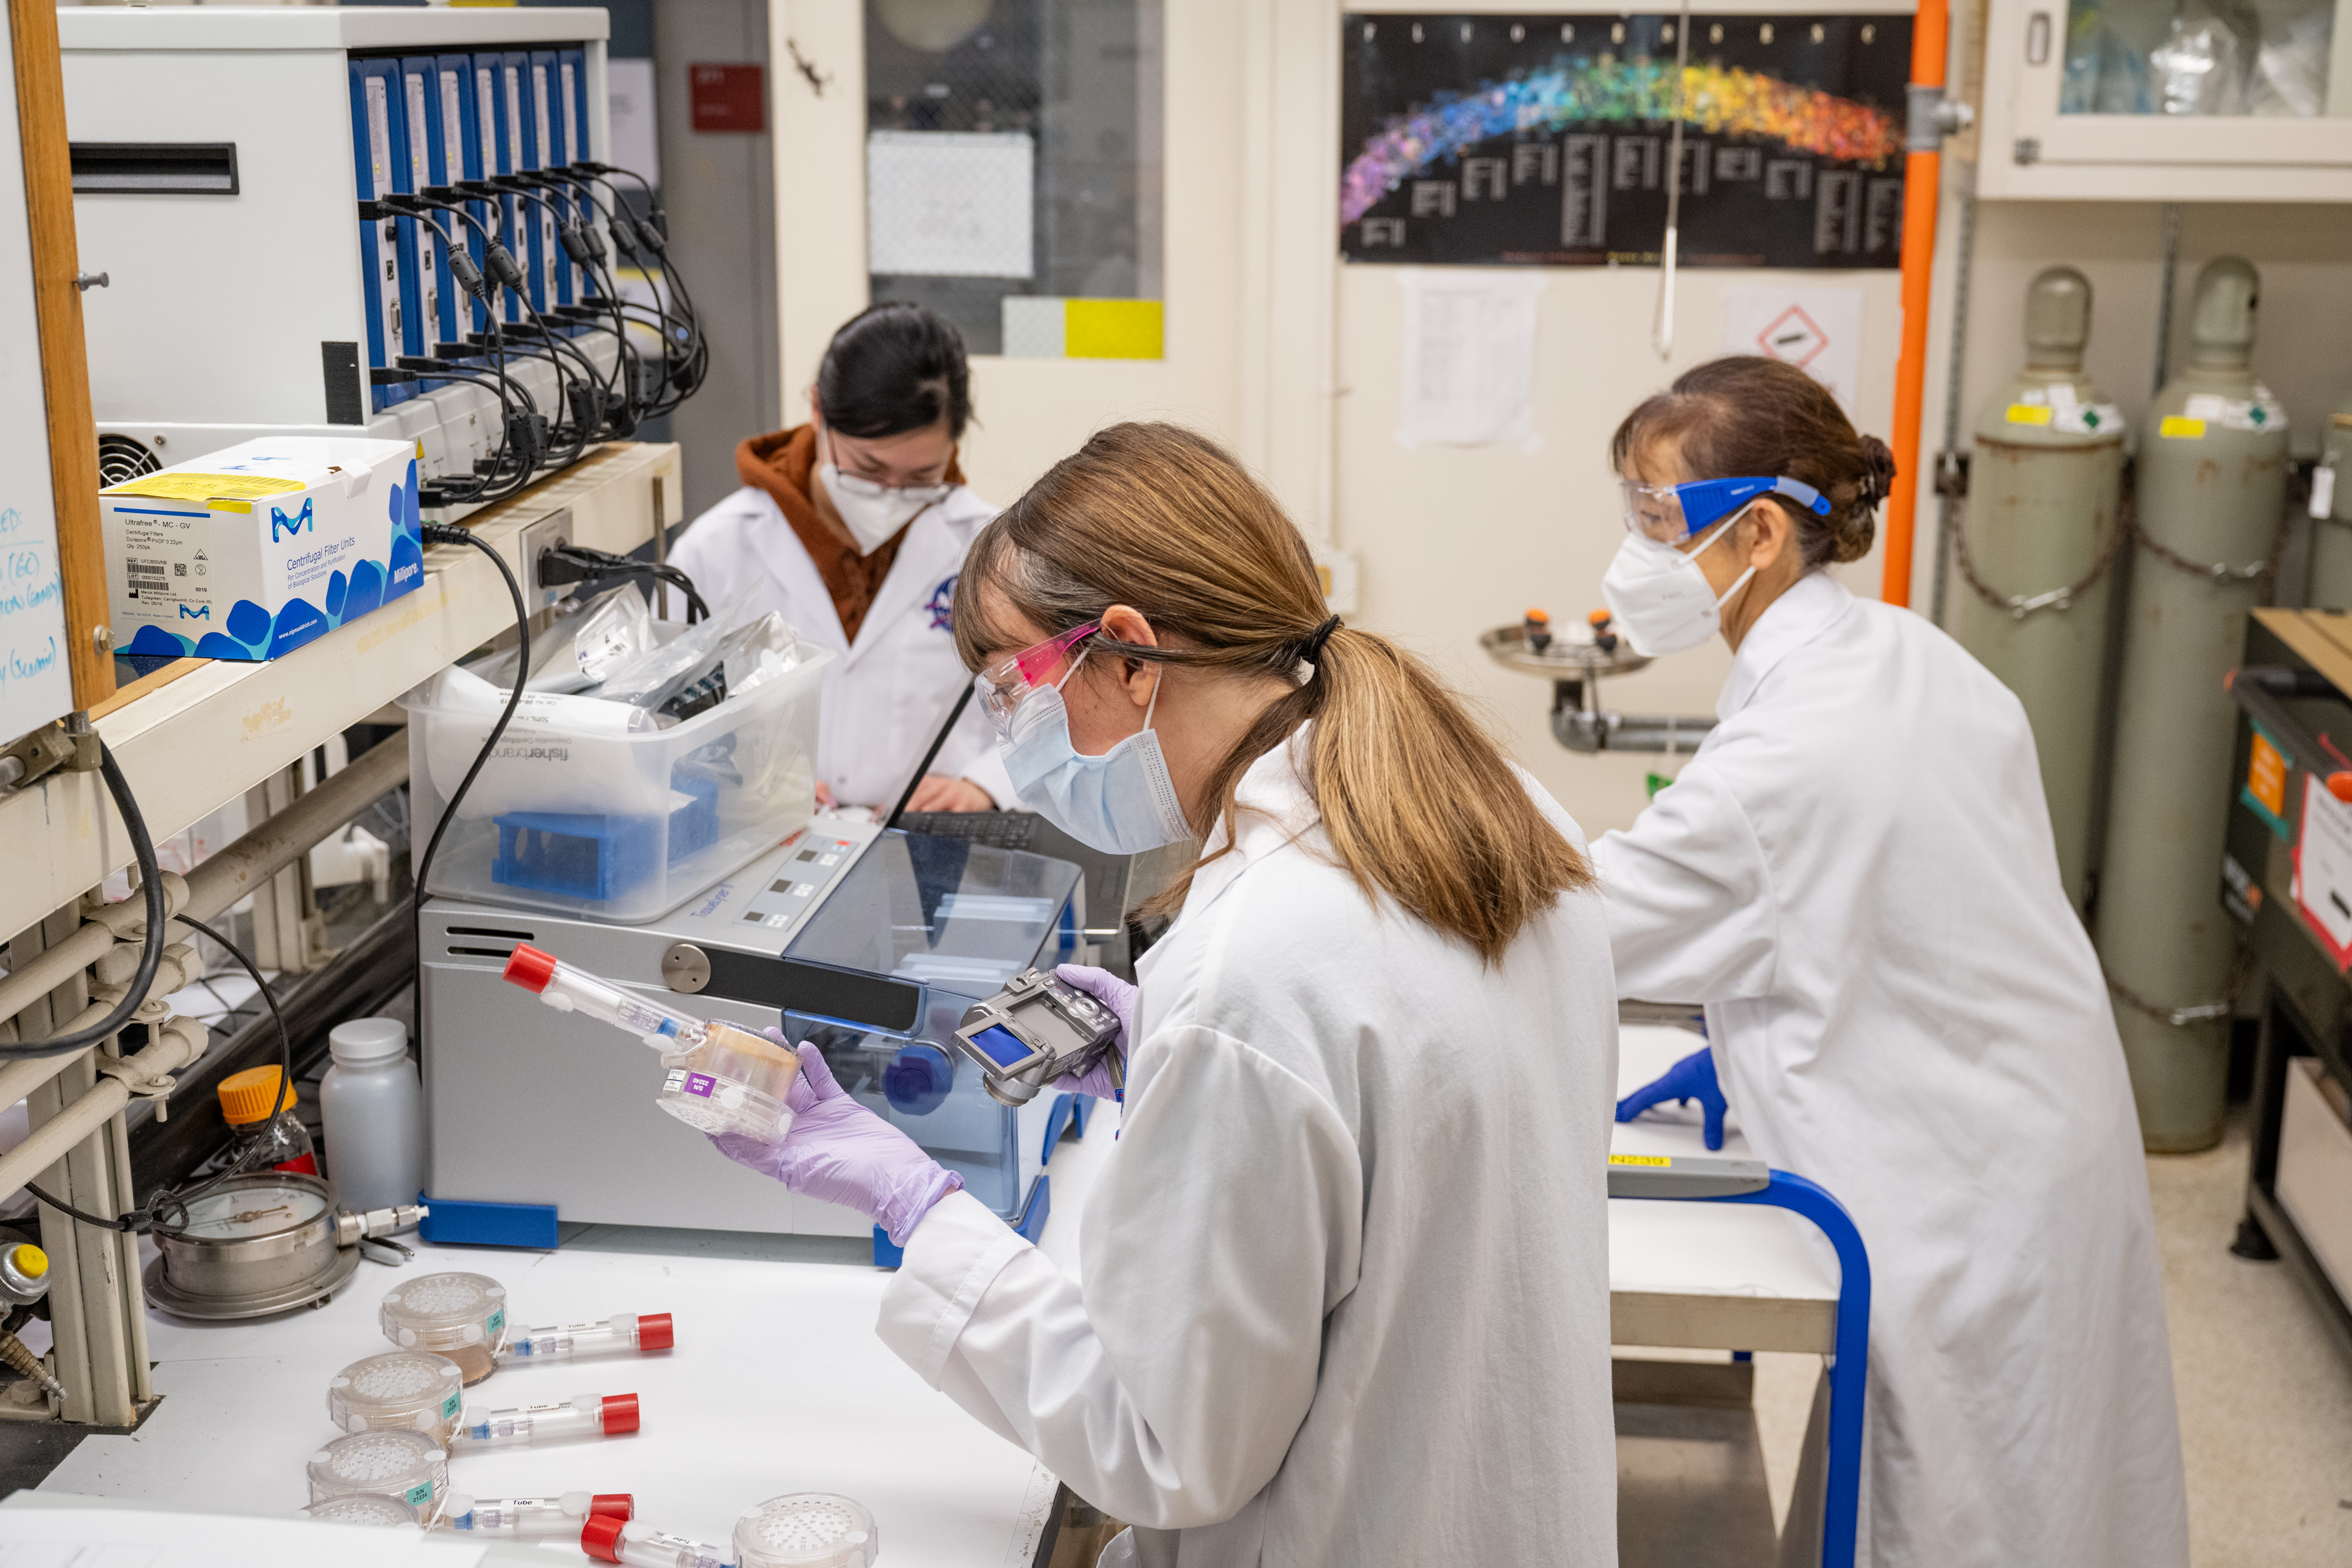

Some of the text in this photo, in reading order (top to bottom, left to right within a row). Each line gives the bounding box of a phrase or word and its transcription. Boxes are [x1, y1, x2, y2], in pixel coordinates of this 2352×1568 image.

[287, 536, 355, 571] Centrifugal Filter Units
[295, 565, 320, 579] Concentration
[328, 554, 346, 566] Purification
[293, 577, 310, 588] Biological
[310, 570, 327, 581] Solutions
[279, 618, 318, 640] www.sigmaaldrich.com
[693, 1077, 710, 1086] 23240
[413, 1492, 428, 1503] 21234
[415, 1488, 425, 1496] S/N
[673, 1536, 691, 1544] Tube
